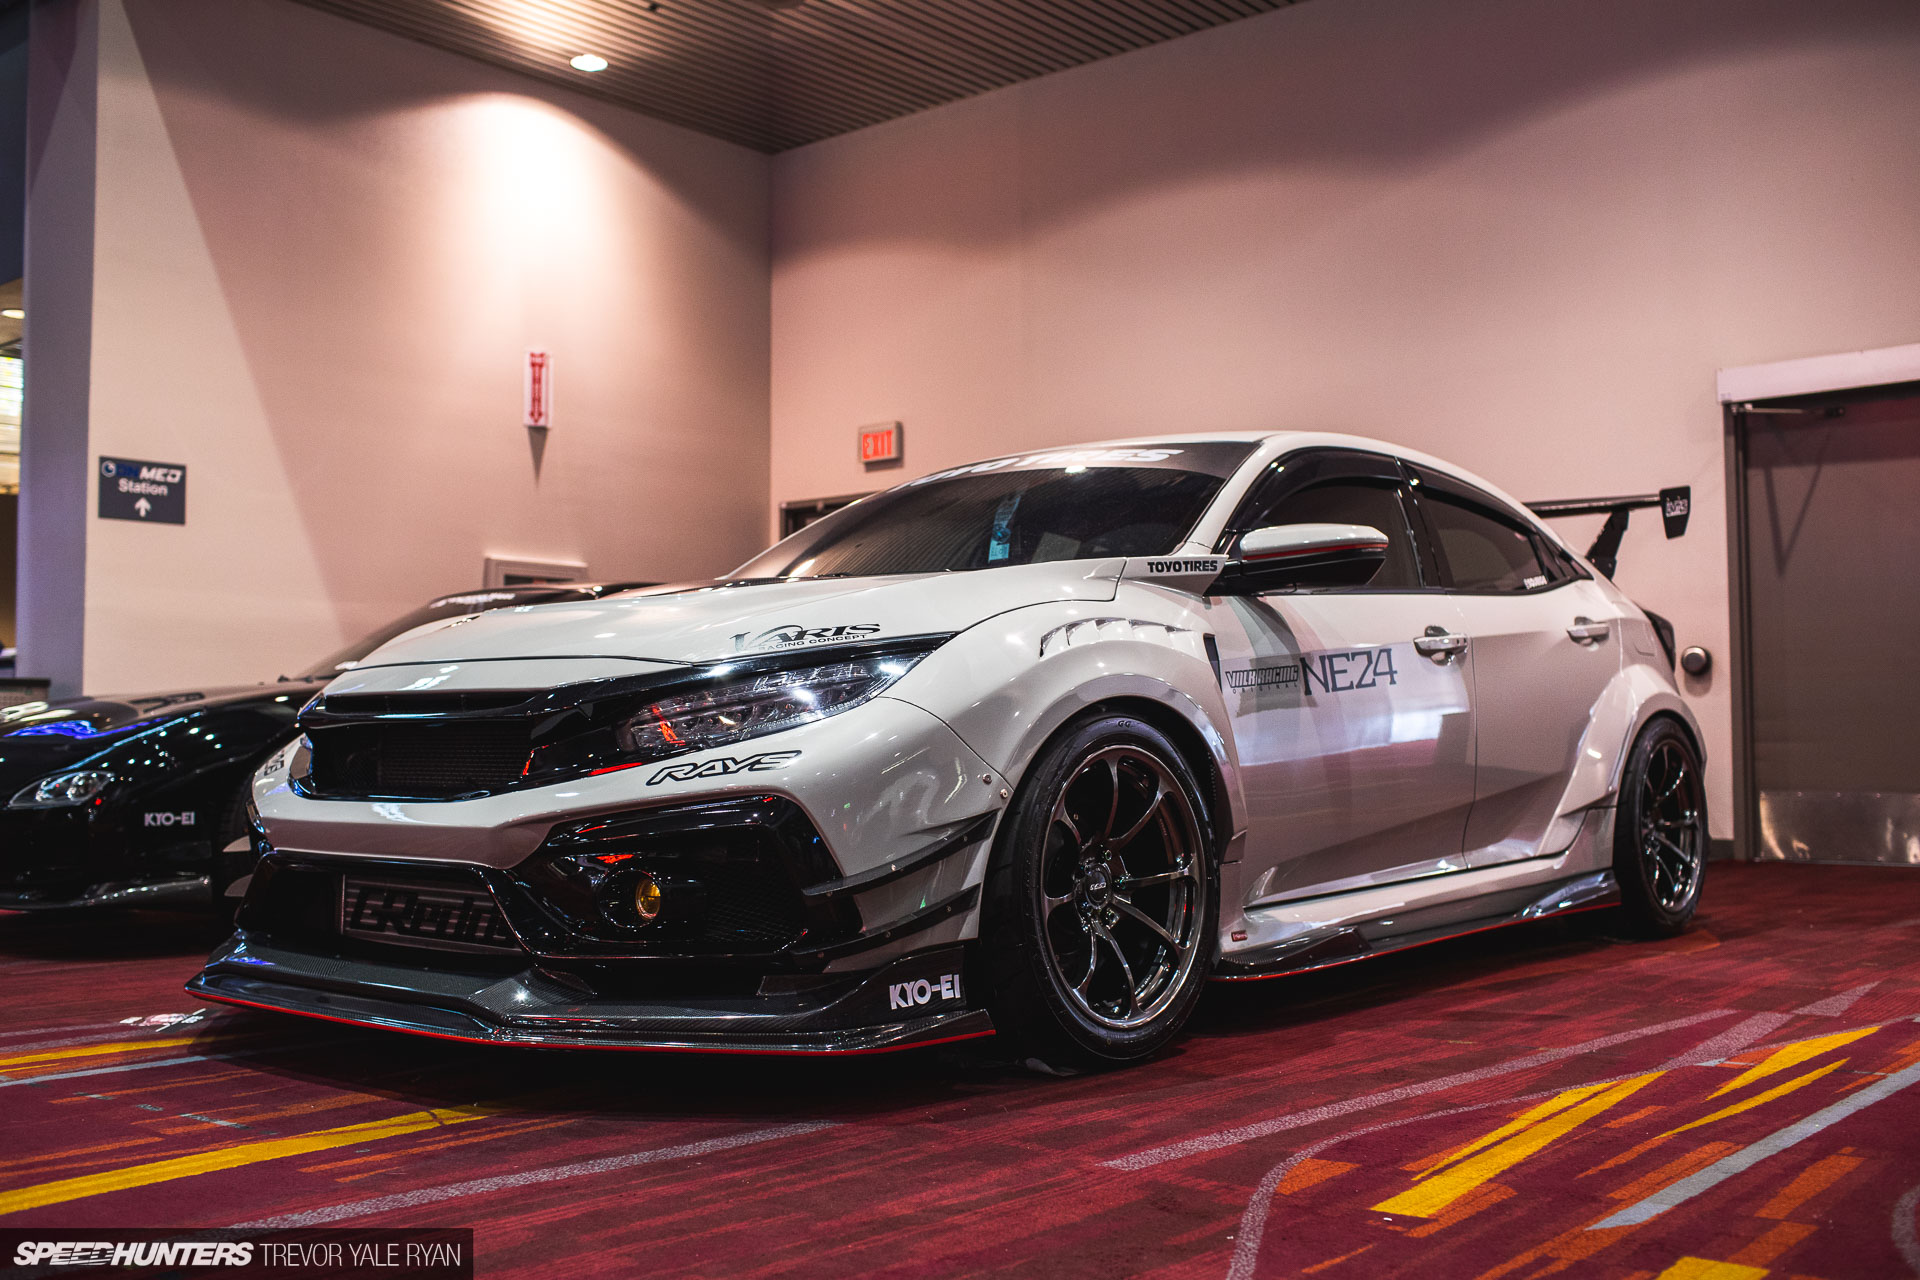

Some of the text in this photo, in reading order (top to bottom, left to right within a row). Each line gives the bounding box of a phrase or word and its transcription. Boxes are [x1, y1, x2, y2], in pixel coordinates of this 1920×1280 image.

[862, 430, 893, 460] EXIT
[118, 478, 168, 496] Station
[809, 634, 866, 644] CONCEPT
[1299, 648, 1398, 696] NE24
[645, 749, 802, 786] RAYS
[144, 811, 196, 826] KYO-EI
[888, 974, 961, 1010] KYO-EI
